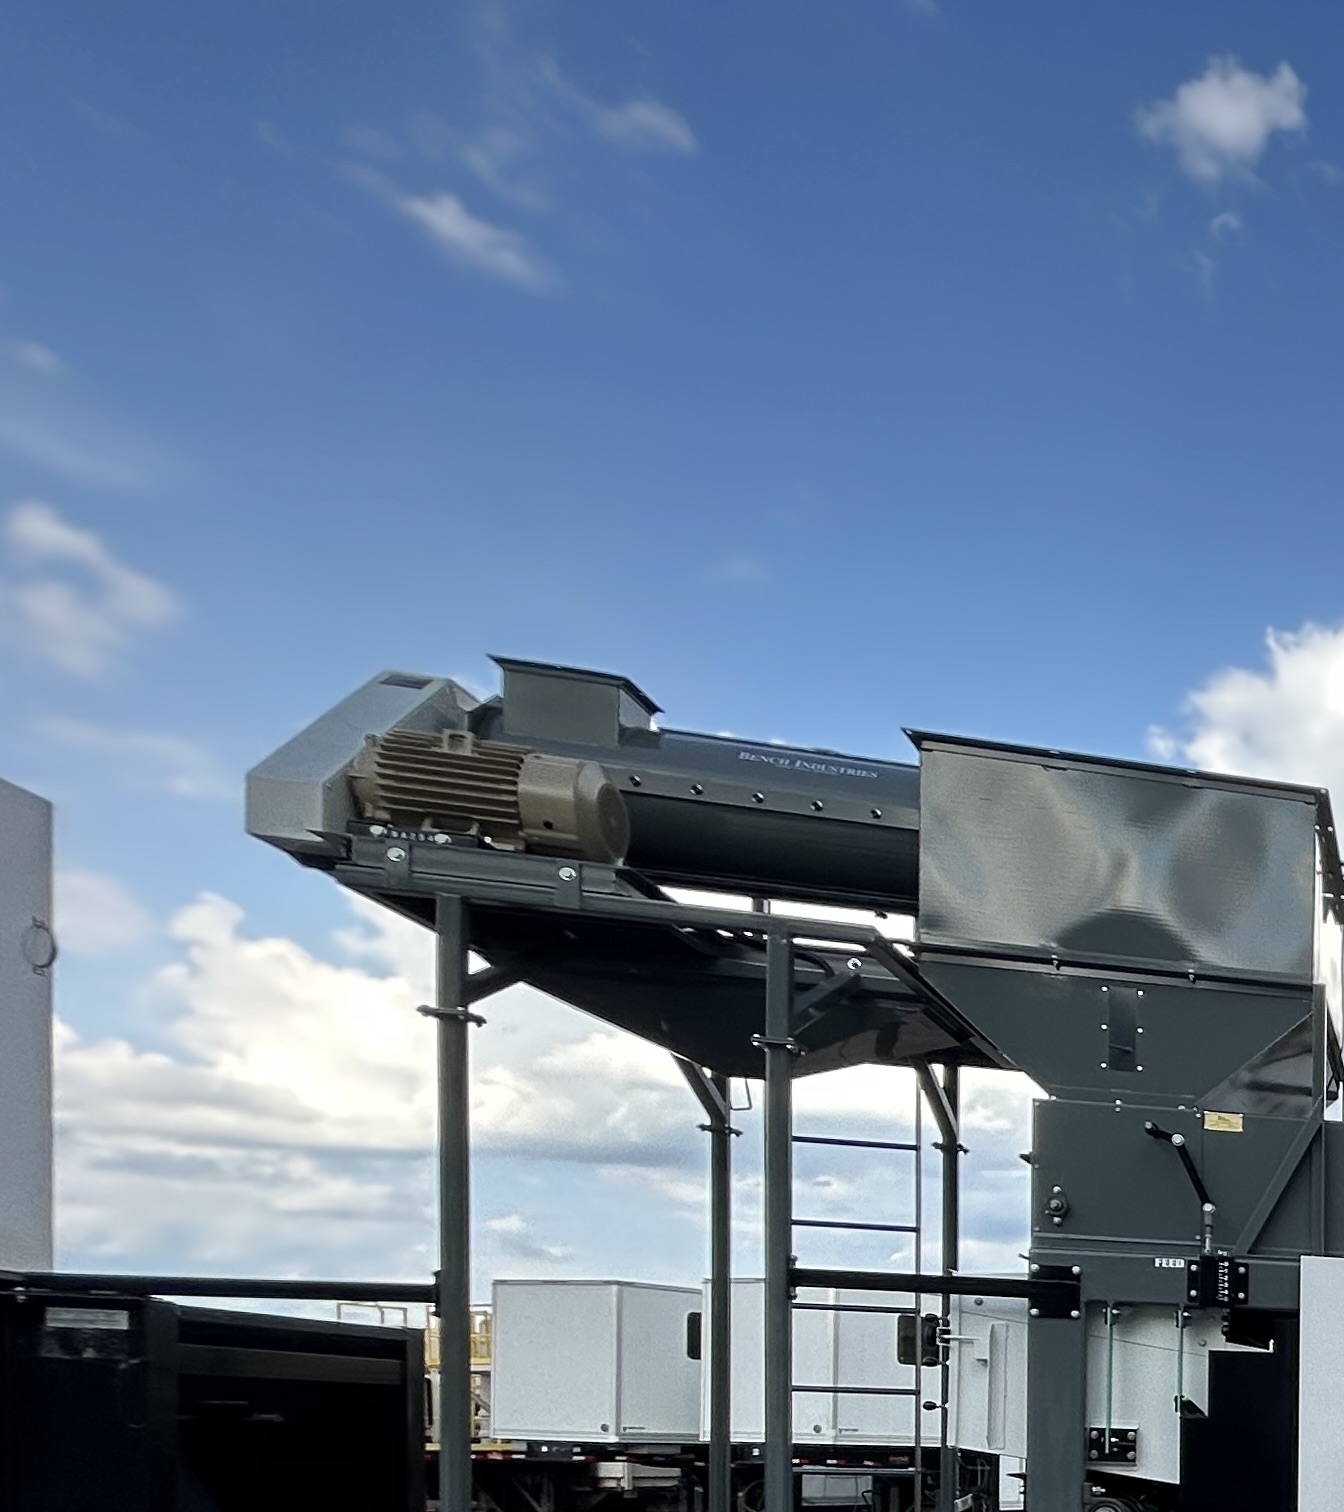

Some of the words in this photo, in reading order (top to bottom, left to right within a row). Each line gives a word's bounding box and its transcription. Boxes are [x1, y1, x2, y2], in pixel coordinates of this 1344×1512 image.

[738, 751, 790, 766] BENCH
[794, 760, 878, 778] INDUSTRIES
[1154, 1258, 1185, 1268] FEED
